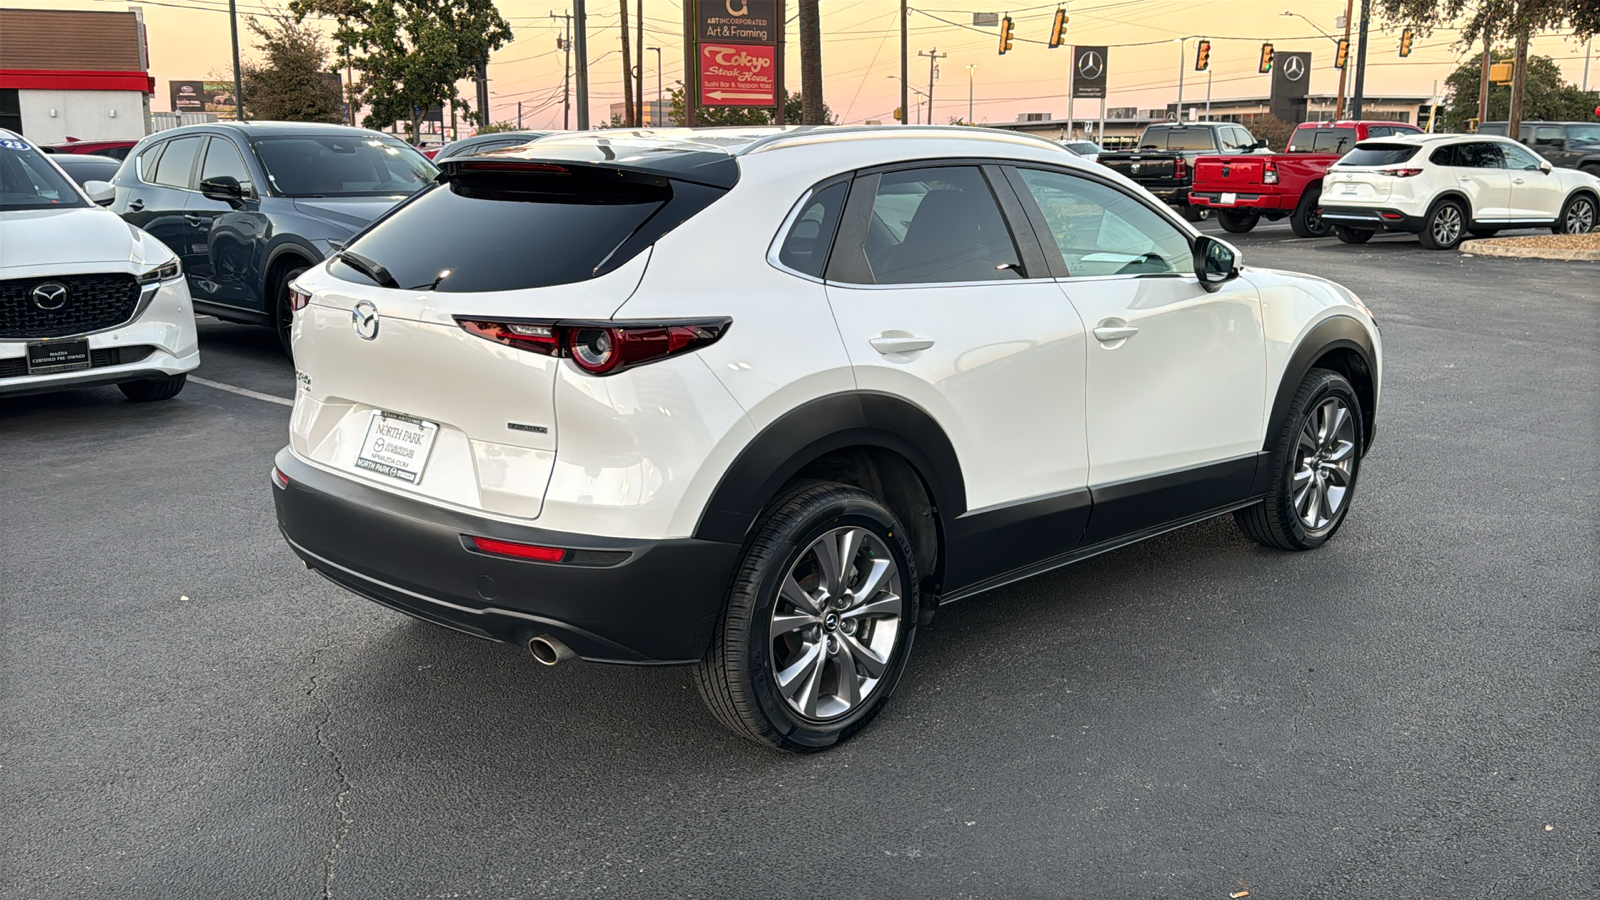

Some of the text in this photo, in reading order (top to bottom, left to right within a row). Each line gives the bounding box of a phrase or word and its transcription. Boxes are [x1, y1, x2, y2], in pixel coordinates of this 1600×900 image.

[720, 18, 767, 26] INCORPORATED
[707, 26, 767, 41] Art & Framing
[703, 46, 771, 73] Tokyo
[703, 66, 773, 83] Steak House
[375, 423, 424, 446] NORTH PARK
[356, 458, 376, 470] NORTH
[375, 464, 390, 475] PARK
